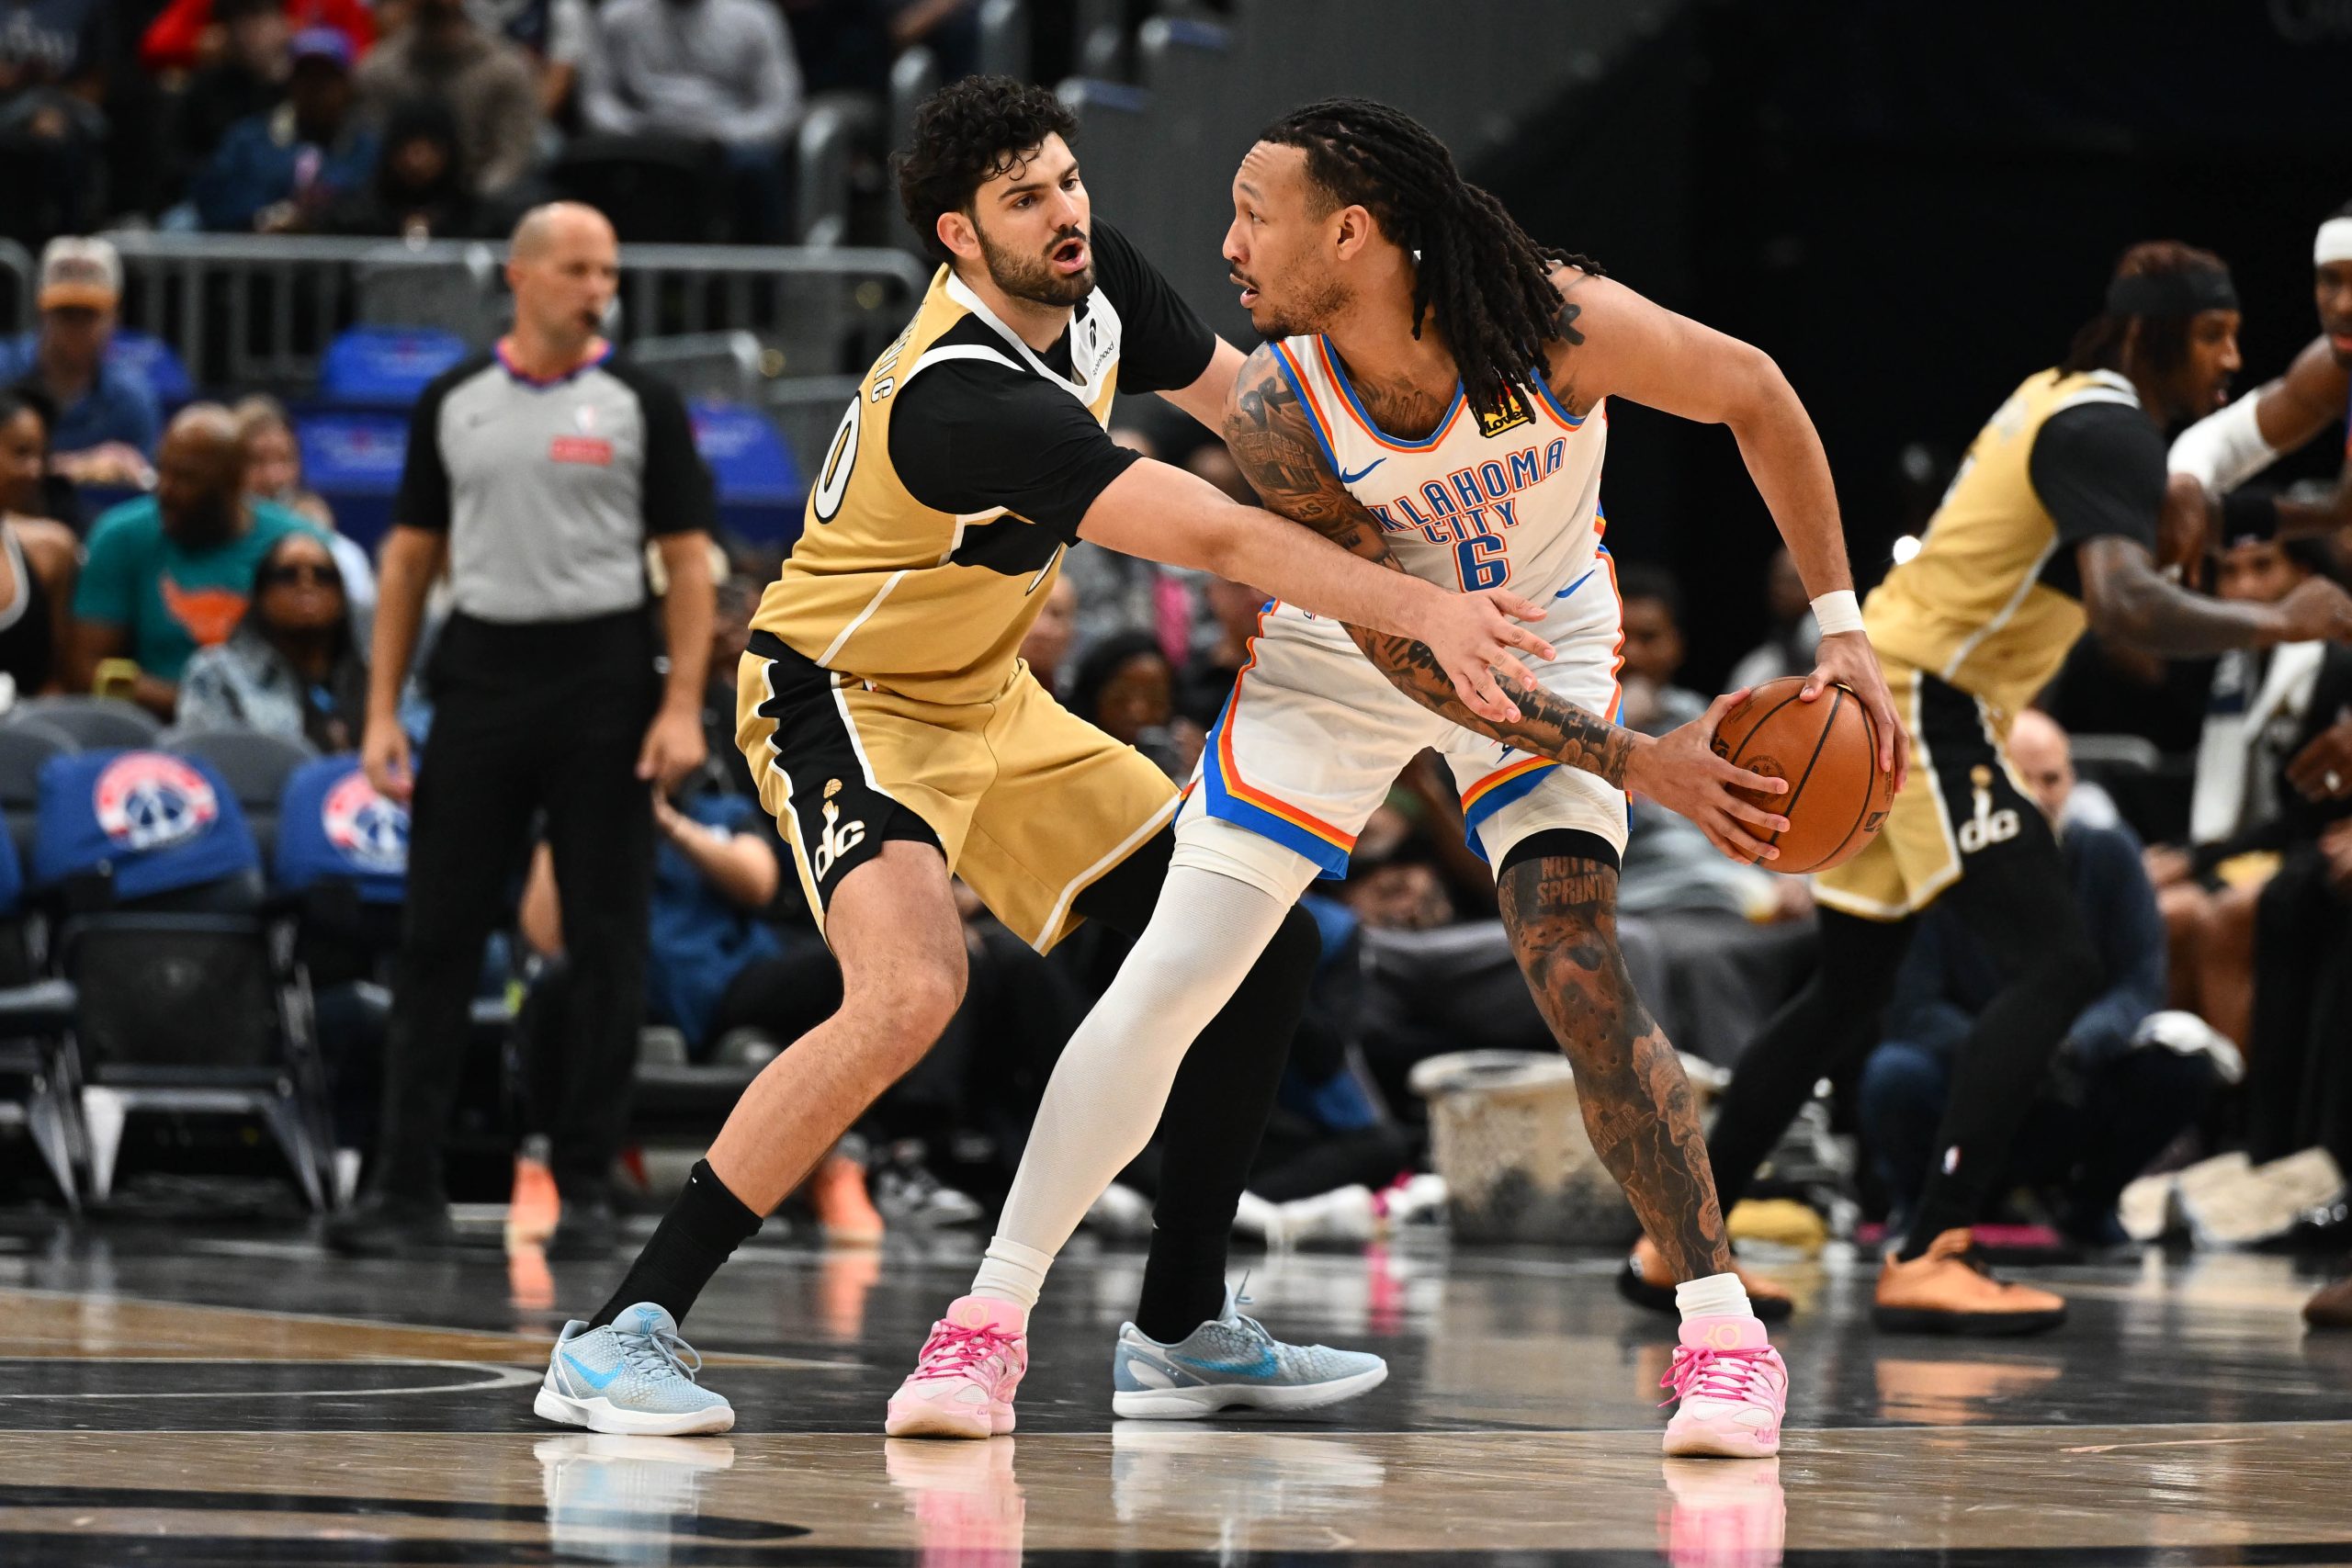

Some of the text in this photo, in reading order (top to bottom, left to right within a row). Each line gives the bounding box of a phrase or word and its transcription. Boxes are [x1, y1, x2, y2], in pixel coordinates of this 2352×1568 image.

[1485, 411, 1523, 433] Love
[1366, 436, 1567, 533] KLAHOMA
[1421, 497, 1520, 546] CITY
[1453, 532, 1511, 594] 6
